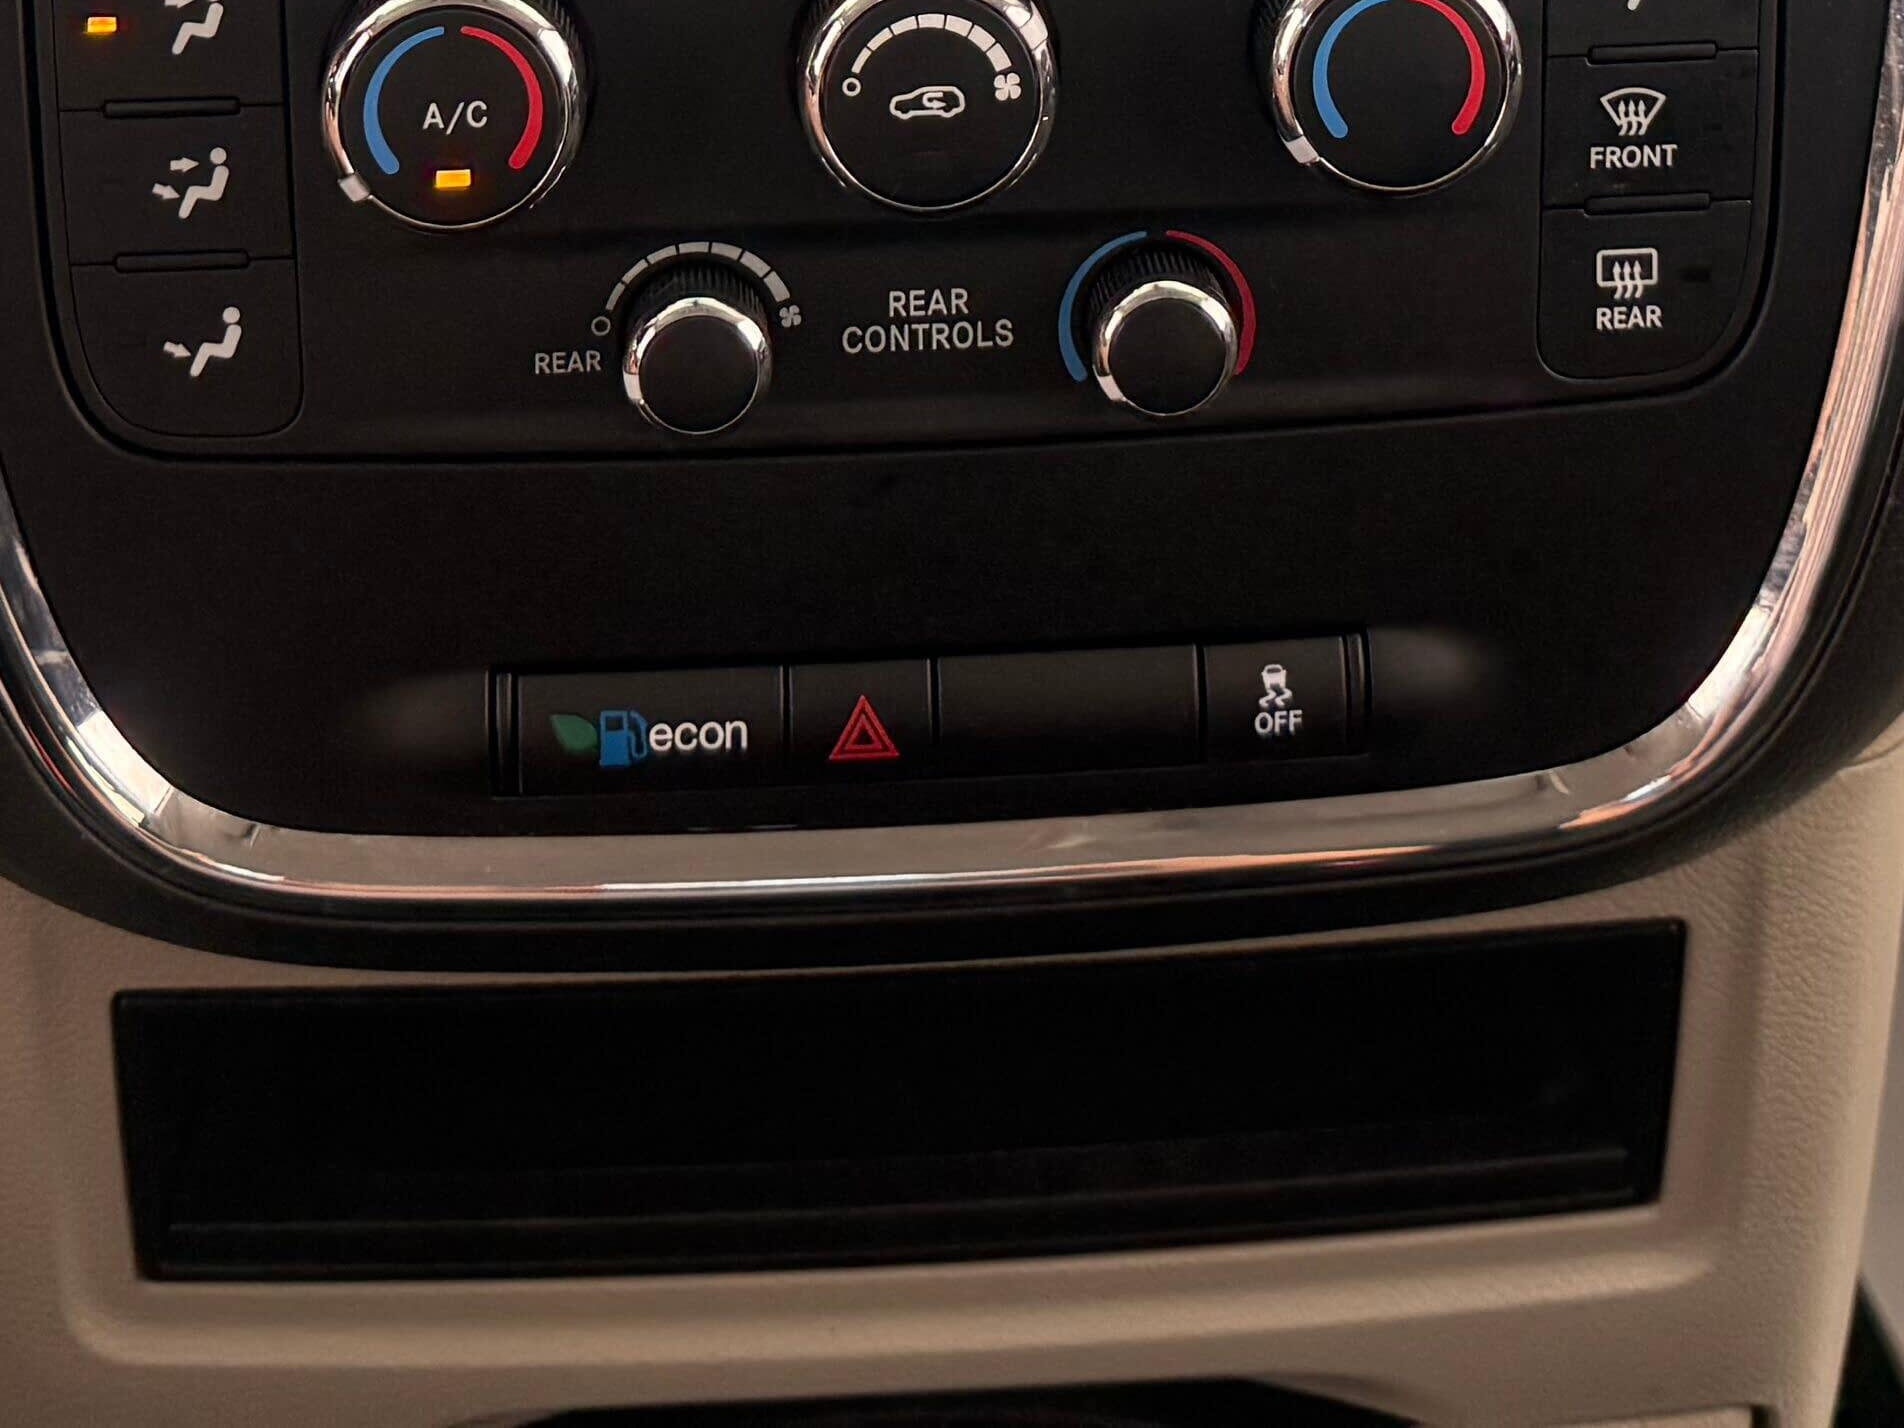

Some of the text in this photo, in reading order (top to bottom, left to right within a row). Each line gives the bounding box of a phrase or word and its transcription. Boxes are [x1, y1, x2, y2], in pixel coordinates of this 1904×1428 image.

[423, 101, 487, 134] A/C
[1591, 144, 1677, 168] FRONT
[890, 288, 968, 317] REAR
[1597, 306, 1661, 329] REAR
[843, 314, 1013, 353] CONTROLS
[535, 351, 600, 374] REAR
[1255, 710, 1302, 733] OFF
[650, 721, 747, 751] econ
